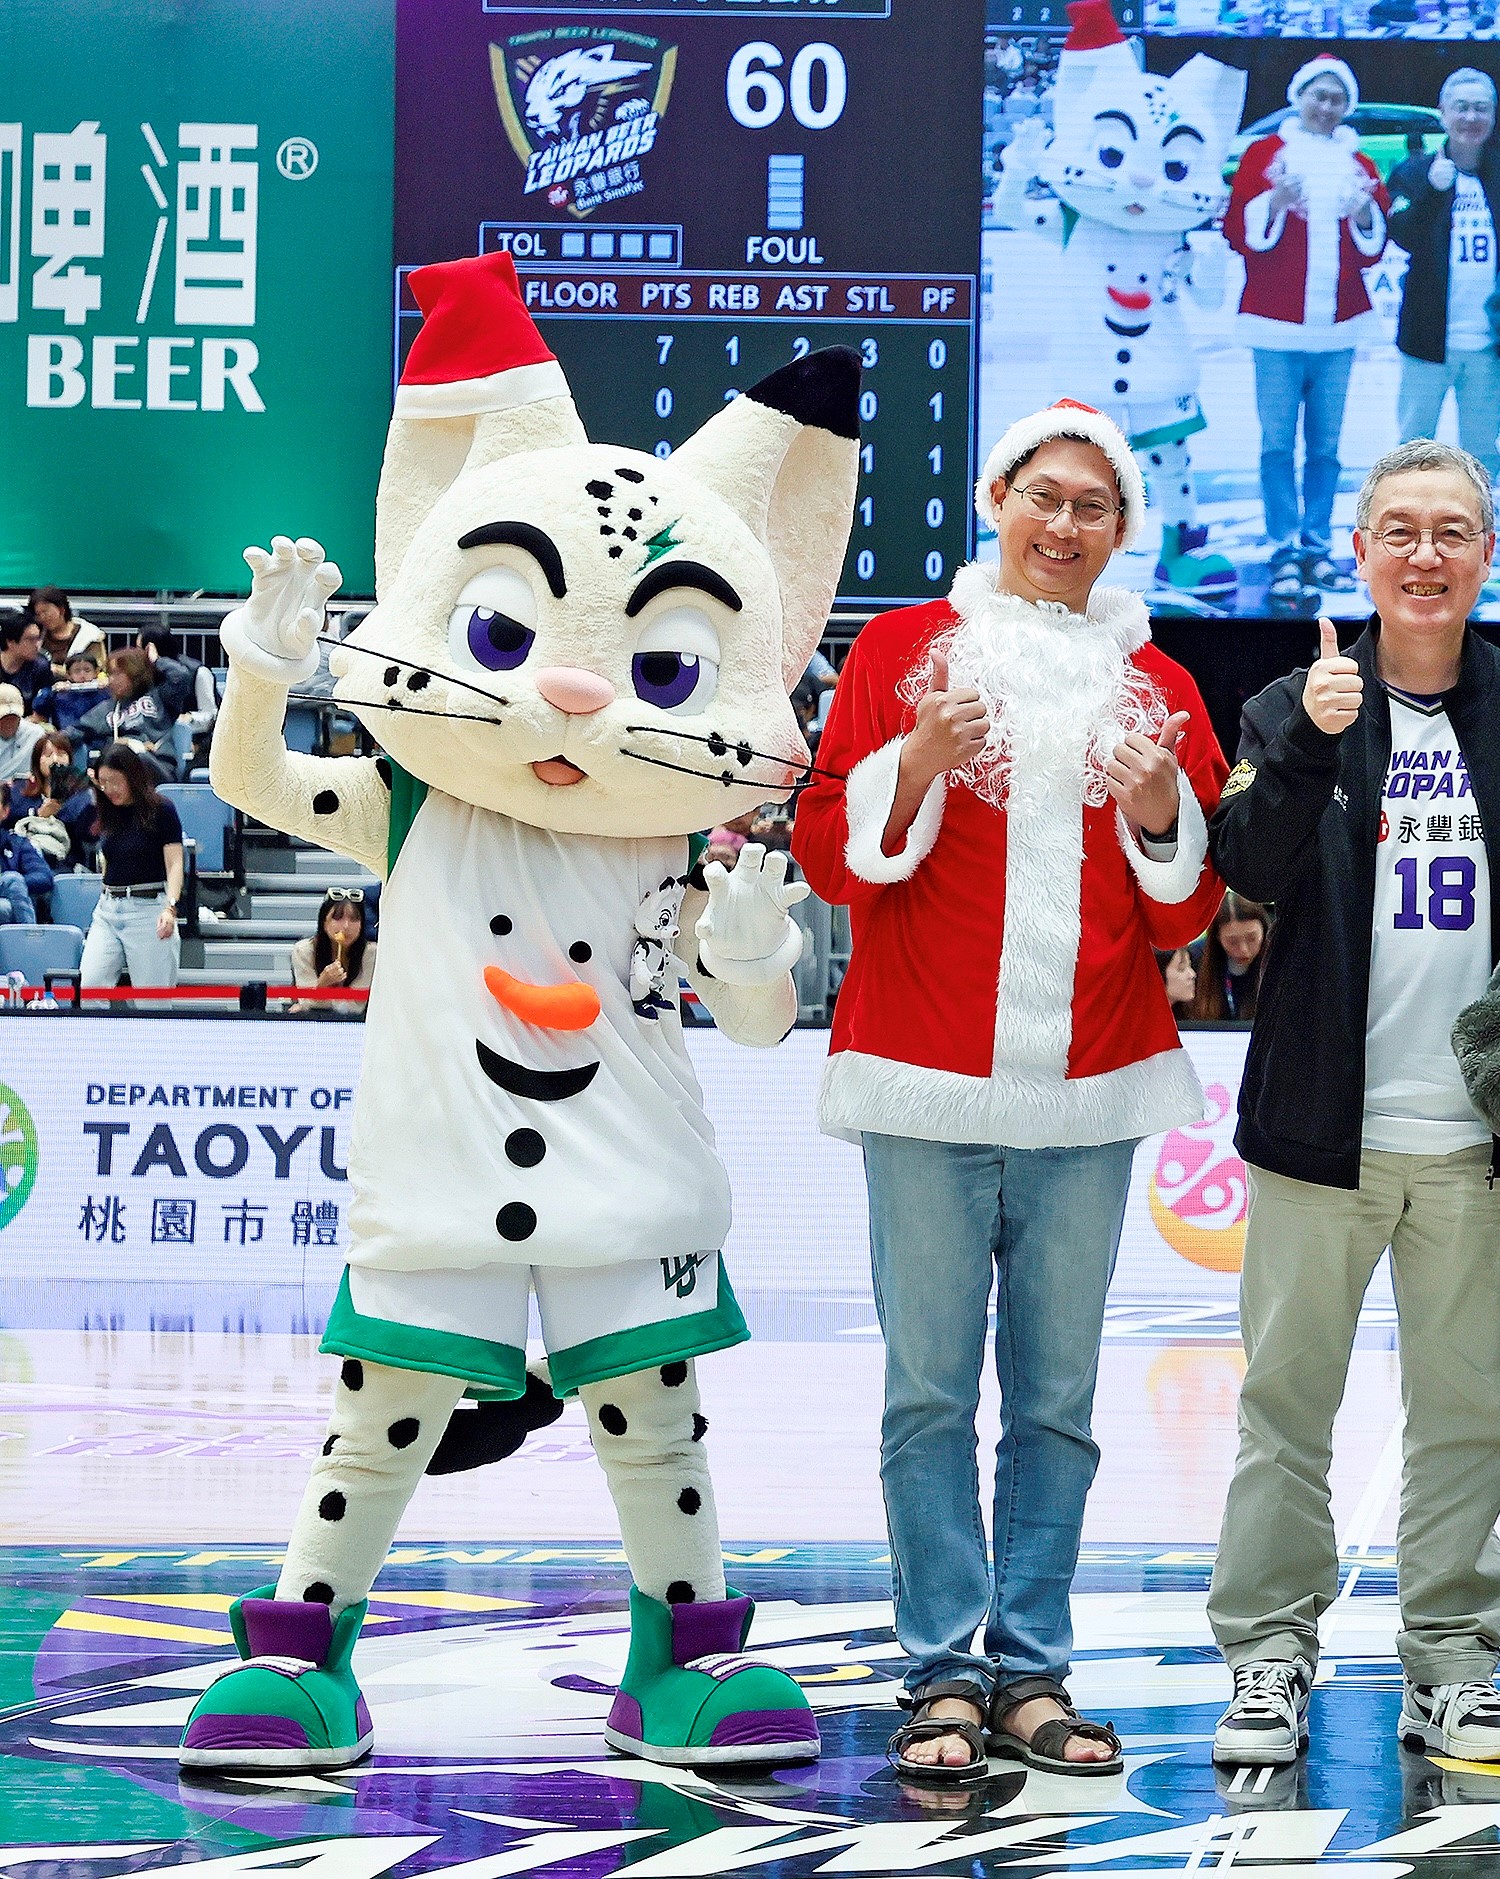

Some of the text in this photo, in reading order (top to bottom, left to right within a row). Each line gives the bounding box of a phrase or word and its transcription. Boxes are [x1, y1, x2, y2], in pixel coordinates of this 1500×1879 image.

[726, 40, 848, 130] 60
[522, 128, 658, 195] LEOPARDS
[498, 232, 547, 258] TOL
[746, 236, 824, 265] FOUL
[1457, 235, 1490, 263] 18
[526, 281, 956, 313] FLOOR PTS REB AST STL PF
[656, 335, 675, 366] 7
[725, 335, 741, 366] 1
[862, 337, 879, 369] 3
[928, 338, 948, 370] 0
[26, 334, 267, 413] BEER
[655, 387, 944, 423] 0 0 1
[862, 443, 875, 474] 1
[927, 444, 942, 475] 1
[859, 496, 944, 529] 1 0
[857, 549, 943, 581] 0 0
[1391, 750, 1452, 771] WAN
[1393, 856, 1477, 931] 18
[86, 1083, 353, 1110] DEPARTMENT OF
